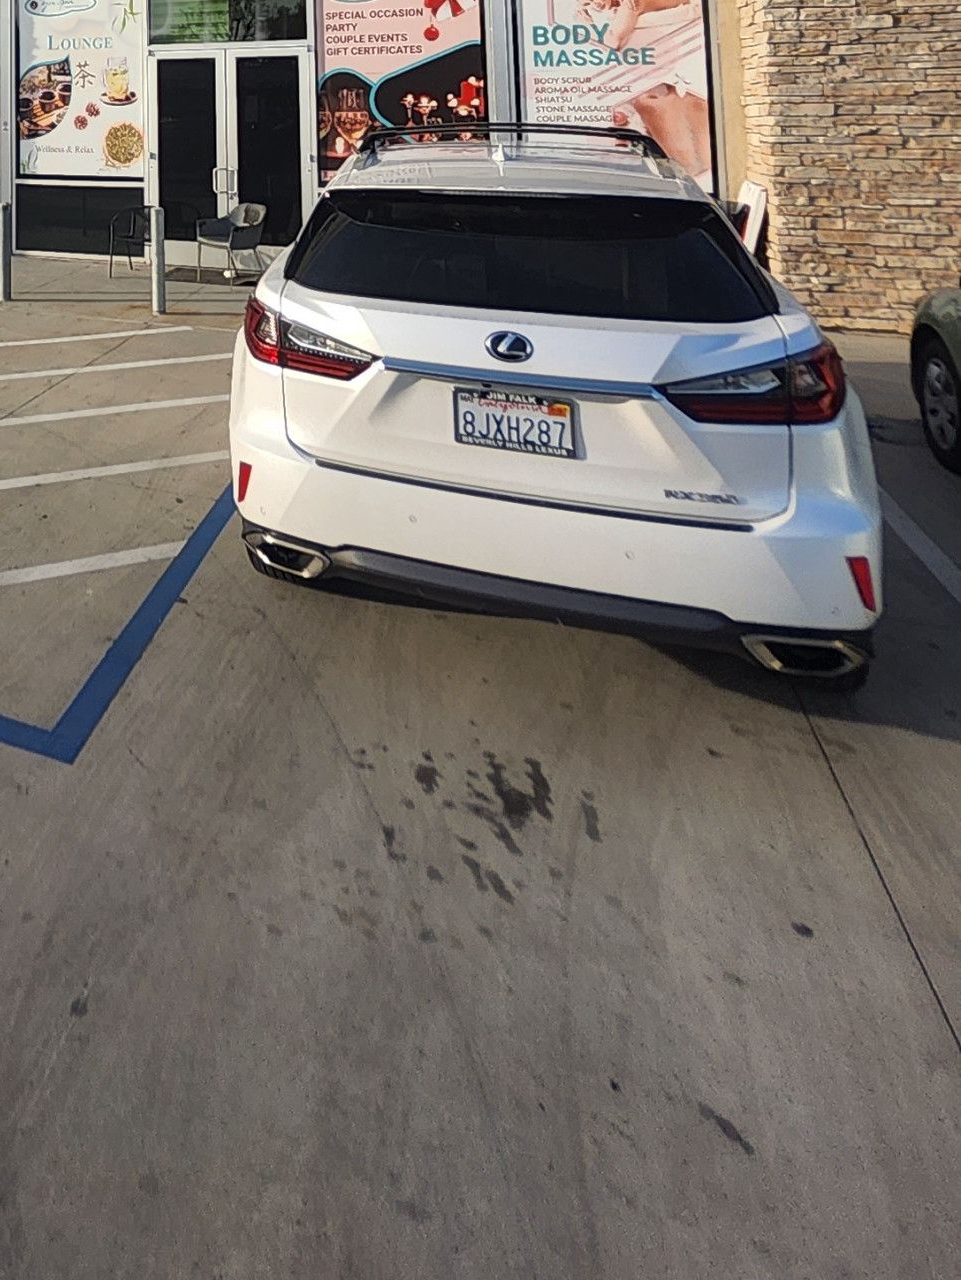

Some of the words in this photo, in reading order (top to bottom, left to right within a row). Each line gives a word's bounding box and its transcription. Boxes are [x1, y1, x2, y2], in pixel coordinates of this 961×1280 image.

[325, 11, 367, 20] SPECIAL
[369, 8, 424, 18] OCCASION
[326, 23, 358, 32] PARTY
[326, 35, 367, 44] COUPLE
[368, 33, 408, 43] EVENTS
[532, 23, 609, 45] BODY
[326, 47, 349, 56] GIFT
[350, 45, 423, 55] CERTIFICATES
[533, 47, 656, 67] MASSAGE
[73, 61, 96, 89] 茶
[534, 77, 560, 85] BODY
[534, 86, 570, 94] AROMA
[536, 105, 566, 113] STONE
[537, 115, 572, 123] COUPLE
[486, 391, 506, 400] JIM
[509, 393, 537, 404] FALK
[463, 410, 566, 448] 8JXH287
[505, 441, 533, 451] HILLS
[536, 445, 568, 456] LEXUS
